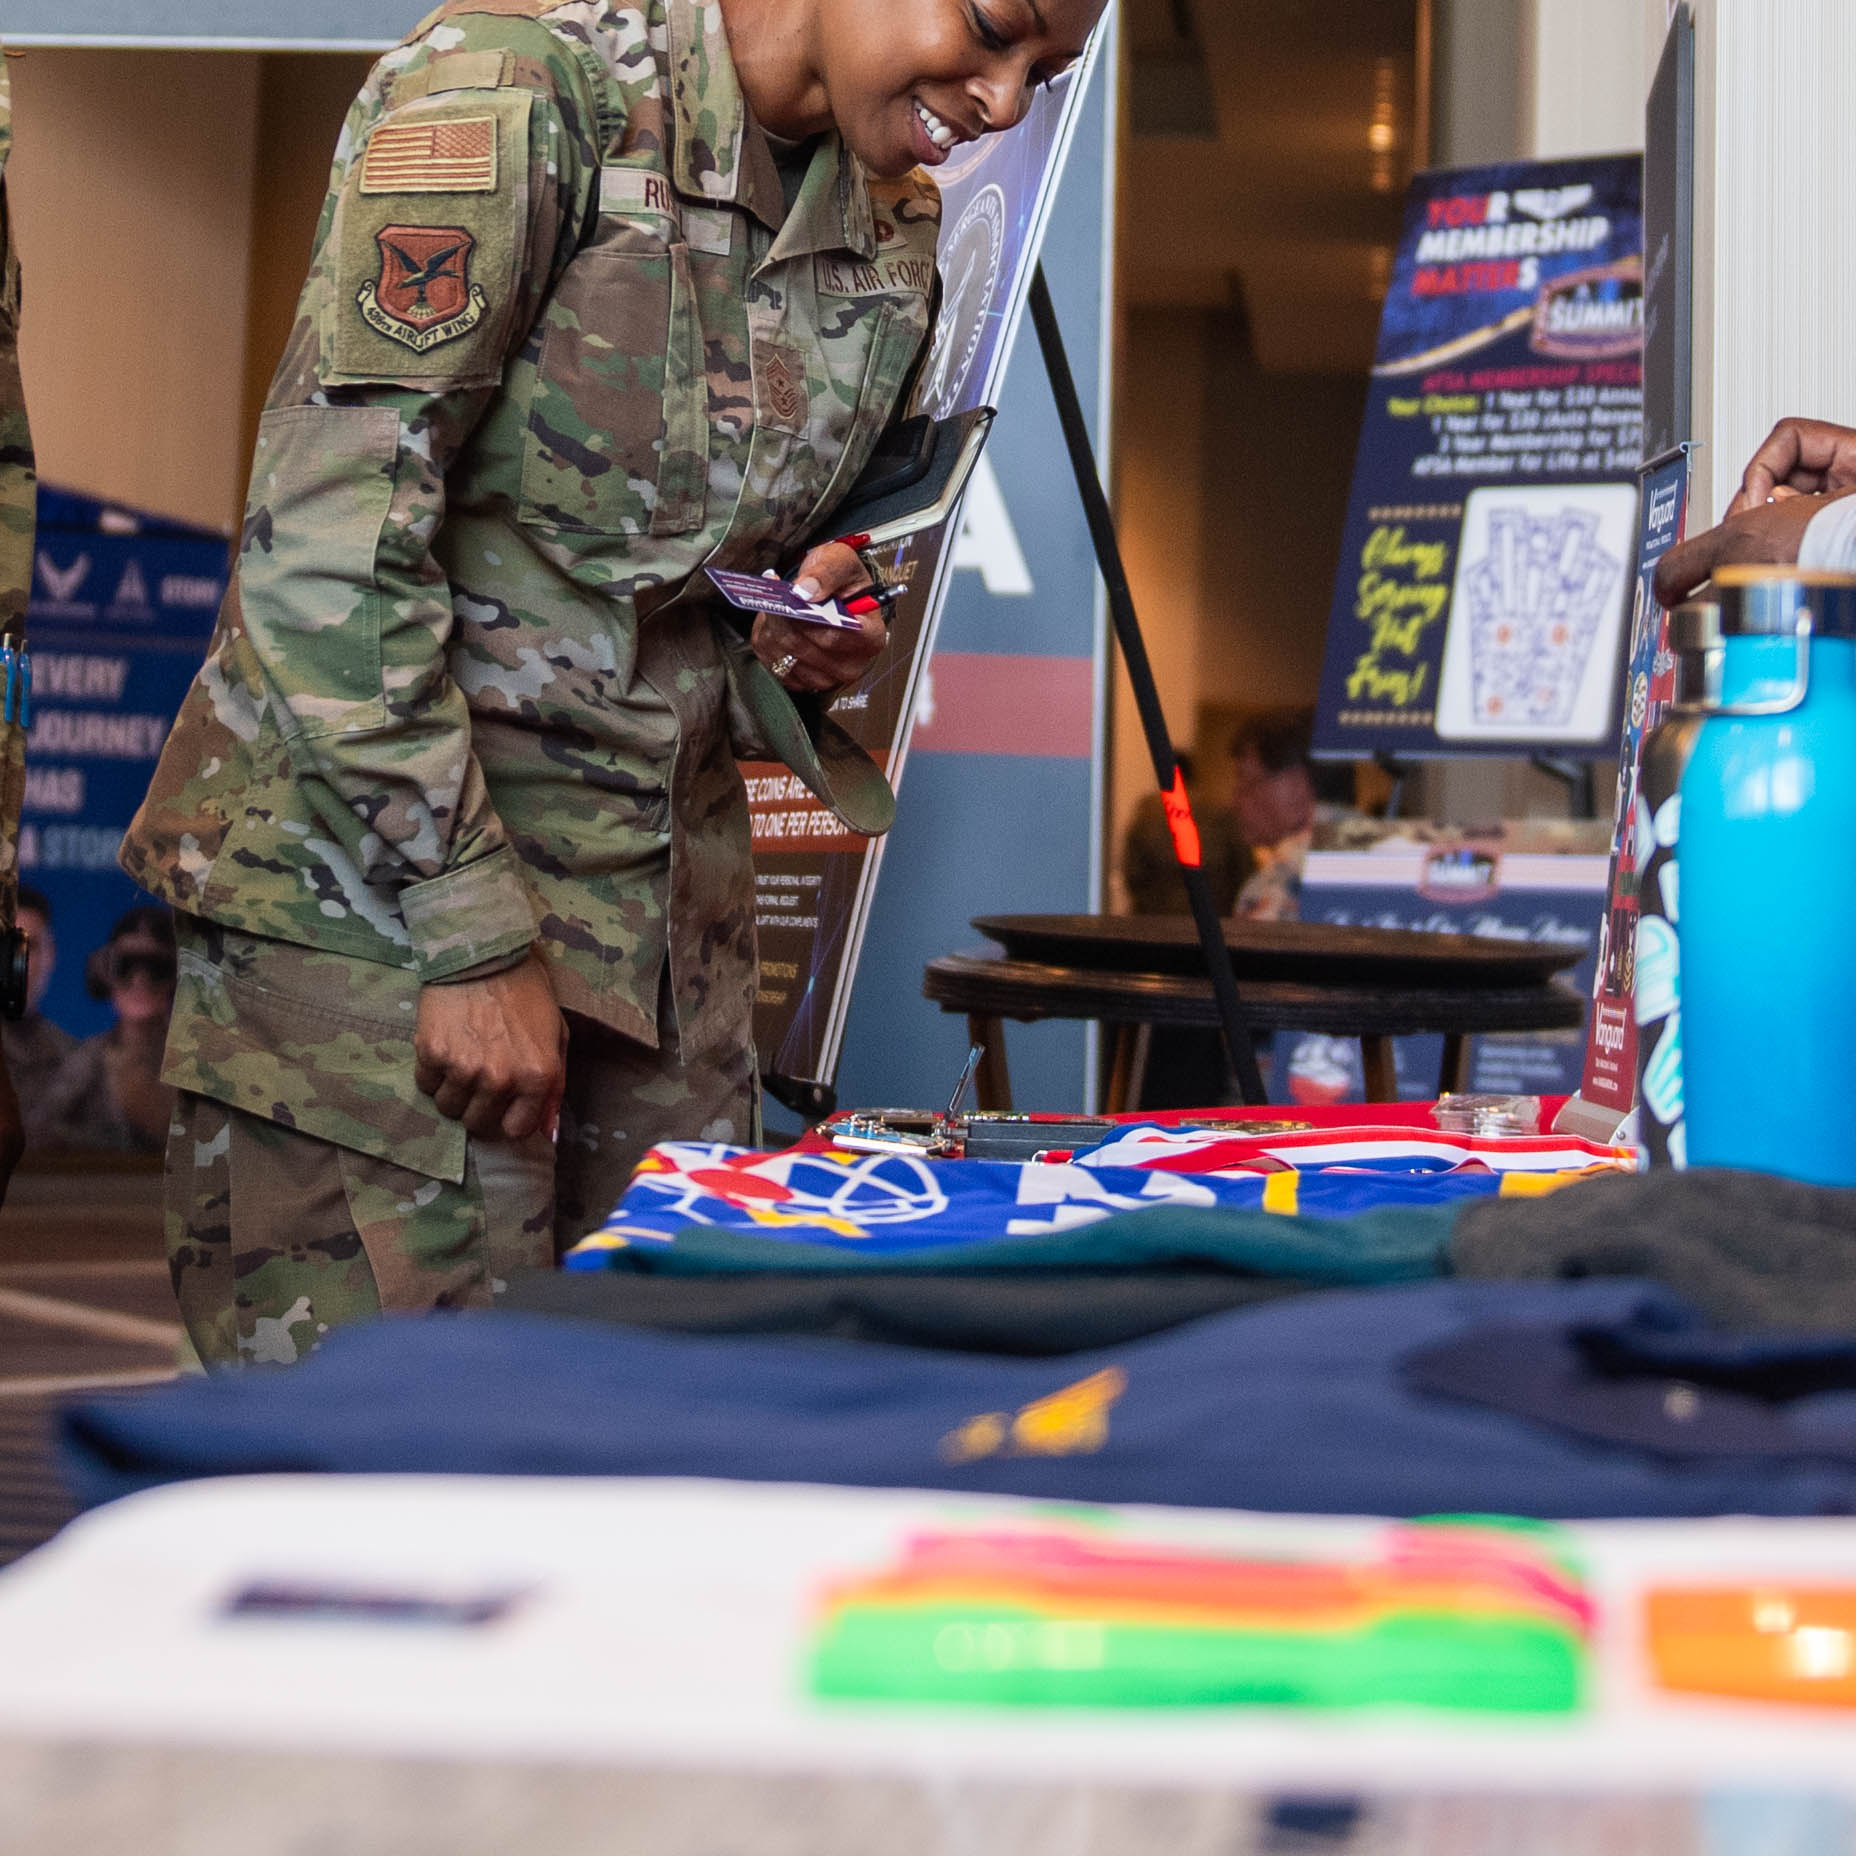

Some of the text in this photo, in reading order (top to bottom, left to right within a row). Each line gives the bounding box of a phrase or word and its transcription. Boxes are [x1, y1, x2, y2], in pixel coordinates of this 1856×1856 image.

[1427, 190, 1510, 228] YOUR
[1414, 214, 1610, 265] MEMBERSHIP
[851, 264, 885, 292] AIR
[884, 259, 930, 290] FORC
[440, 312, 475, 337] WING
[757, 775, 787, 802] COINS
[1595, 1001, 1627, 1055] Vanguard
